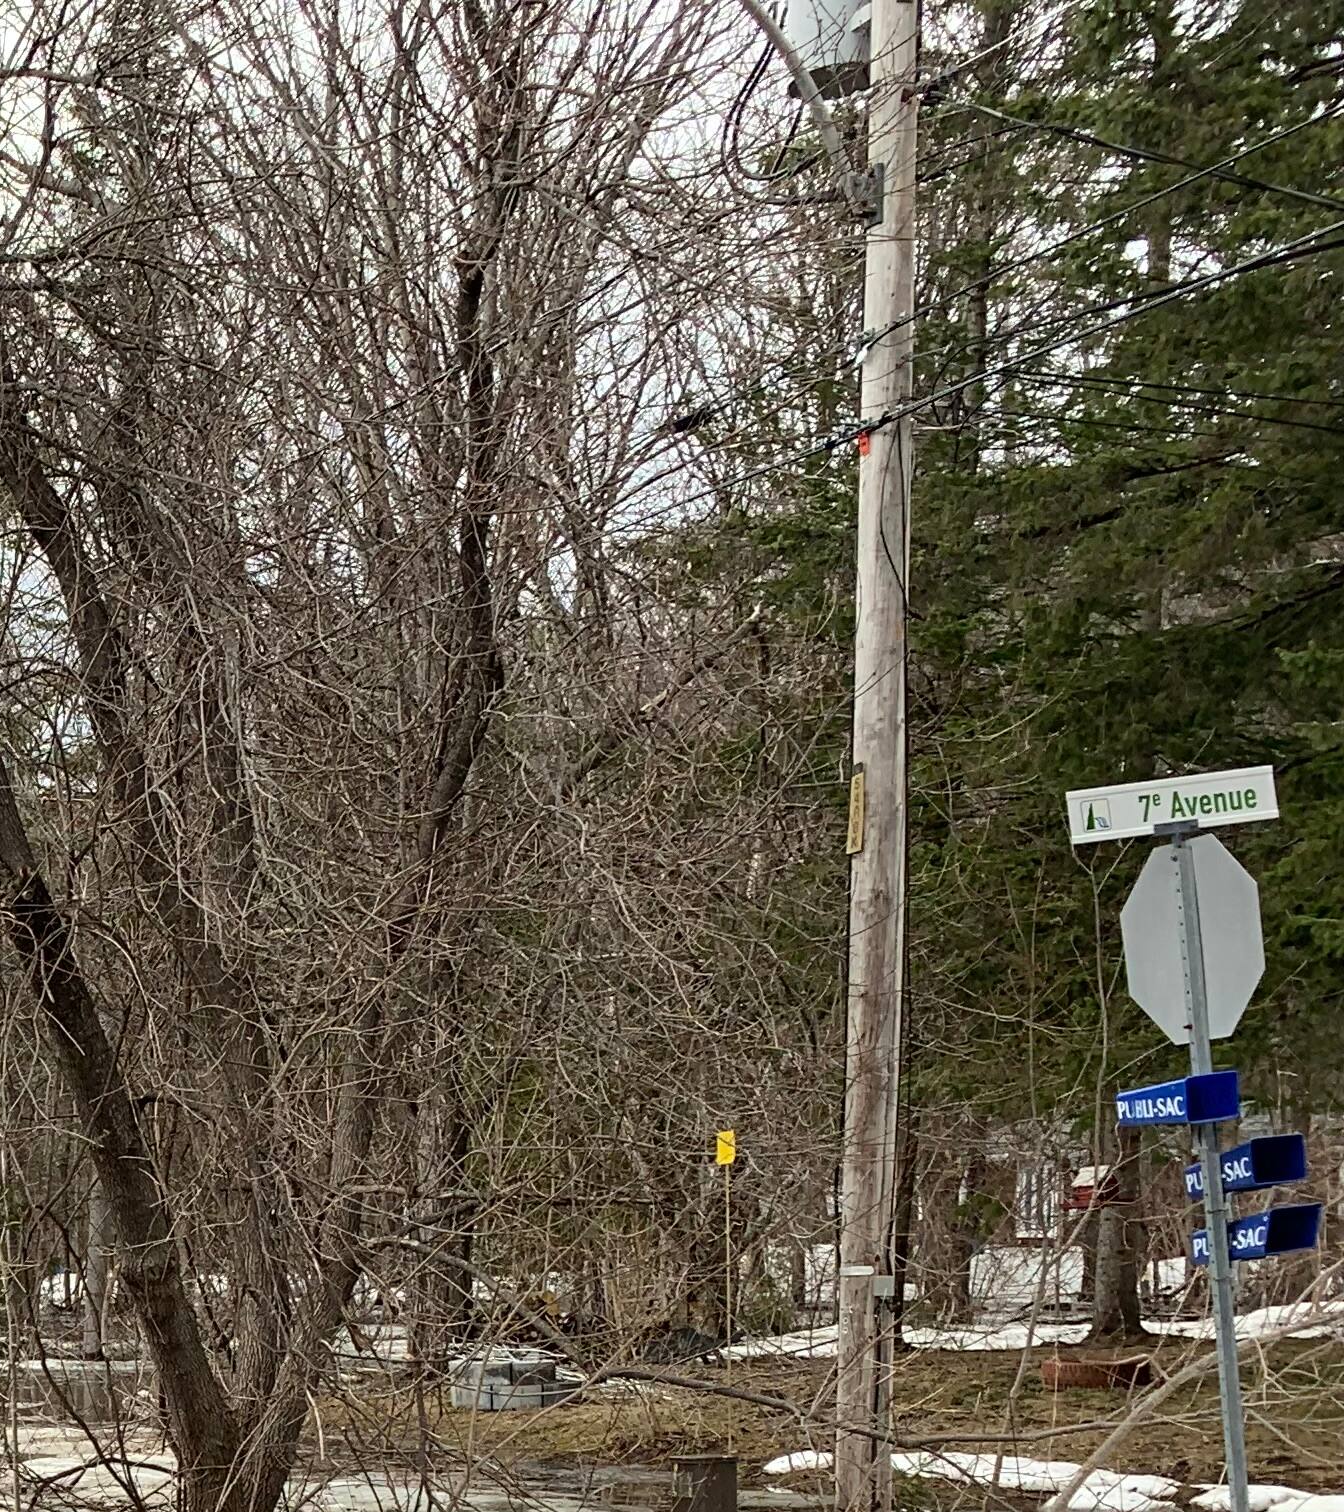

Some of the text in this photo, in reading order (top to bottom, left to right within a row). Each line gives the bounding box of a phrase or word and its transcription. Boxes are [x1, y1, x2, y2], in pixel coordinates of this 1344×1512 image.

[1138, 787, 1258, 823] 7e Avenue
[1116, 1095, 1186, 1120] PUBLI-SAC
[1185, 1156, 1253, 1193] PU-SAC
[1192, 1225, 1266, 1258] PU-SAC
